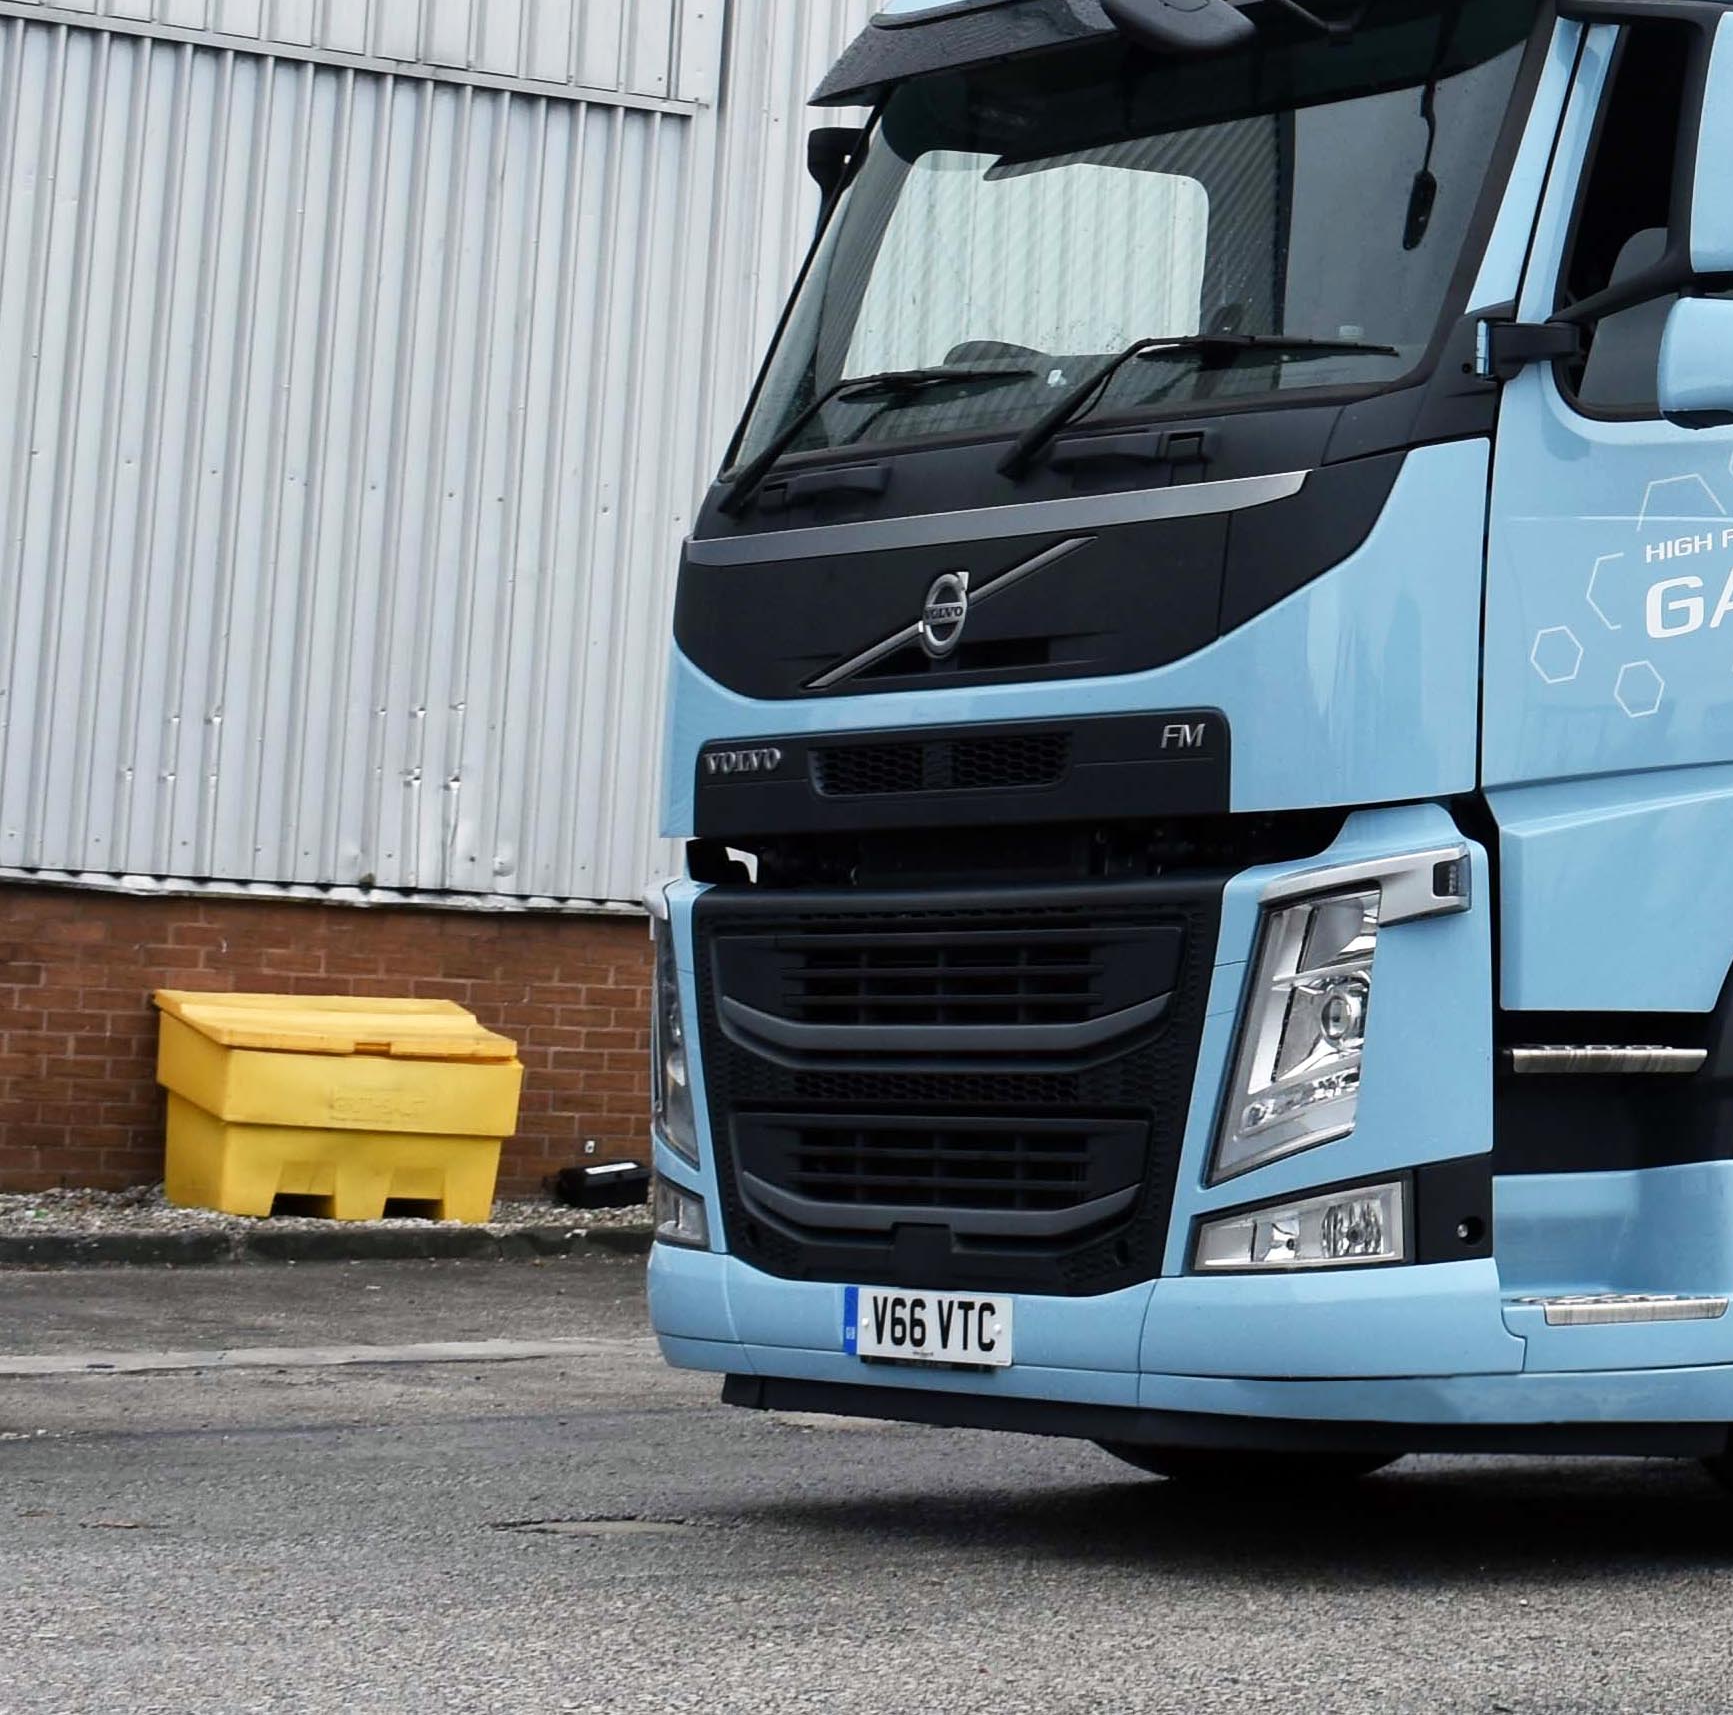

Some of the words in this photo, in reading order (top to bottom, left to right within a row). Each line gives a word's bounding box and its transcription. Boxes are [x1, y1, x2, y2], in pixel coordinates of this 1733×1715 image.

[1646, 533, 1713, 563] HIGH
[1160, 723, 1206, 748] FM
[703, 748, 781, 774] VOLVO
[873, 1296, 926, 1348] V66
[937, 1300, 996, 1352] VTC
